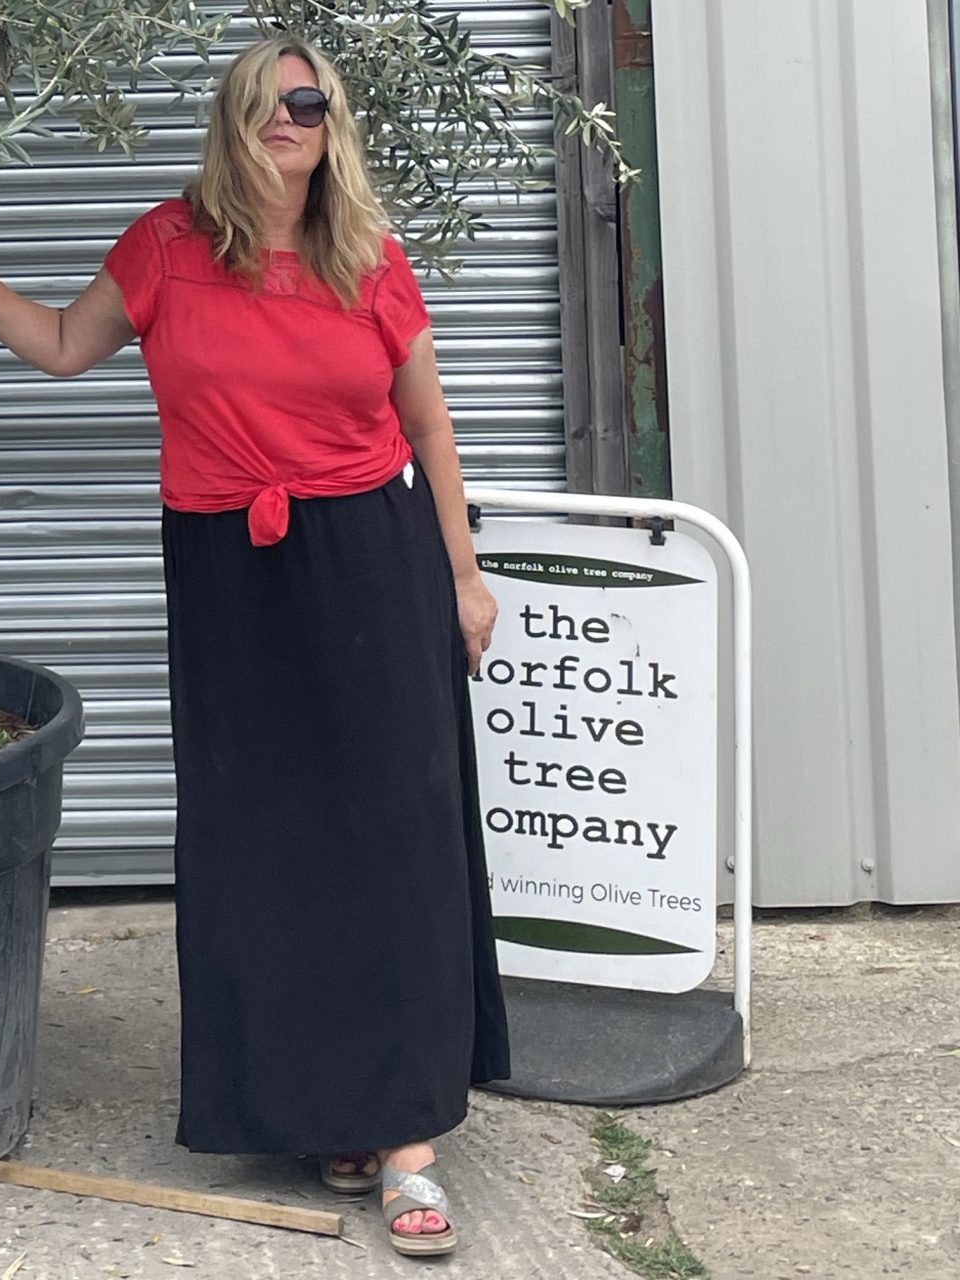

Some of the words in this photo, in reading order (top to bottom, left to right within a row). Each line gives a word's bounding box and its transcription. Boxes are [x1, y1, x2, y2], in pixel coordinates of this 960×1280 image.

[481, 559, 499, 570] the
[503, 561, 544, 572] norfolk
[548, 564, 578, 575] olive
[583, 566, 607, 577] tree
[612, 570, 653, 582] company
[519, 604, 610, 643] the
[486, 701, 644, 746] olive
[504, 751, 627, 794] tree
[486, 807, 678, 860] ompany
[501, 874, 584, 904] winning
[590, 883, 642, 906] Olive
[647, 888, 702, 912] Trees
